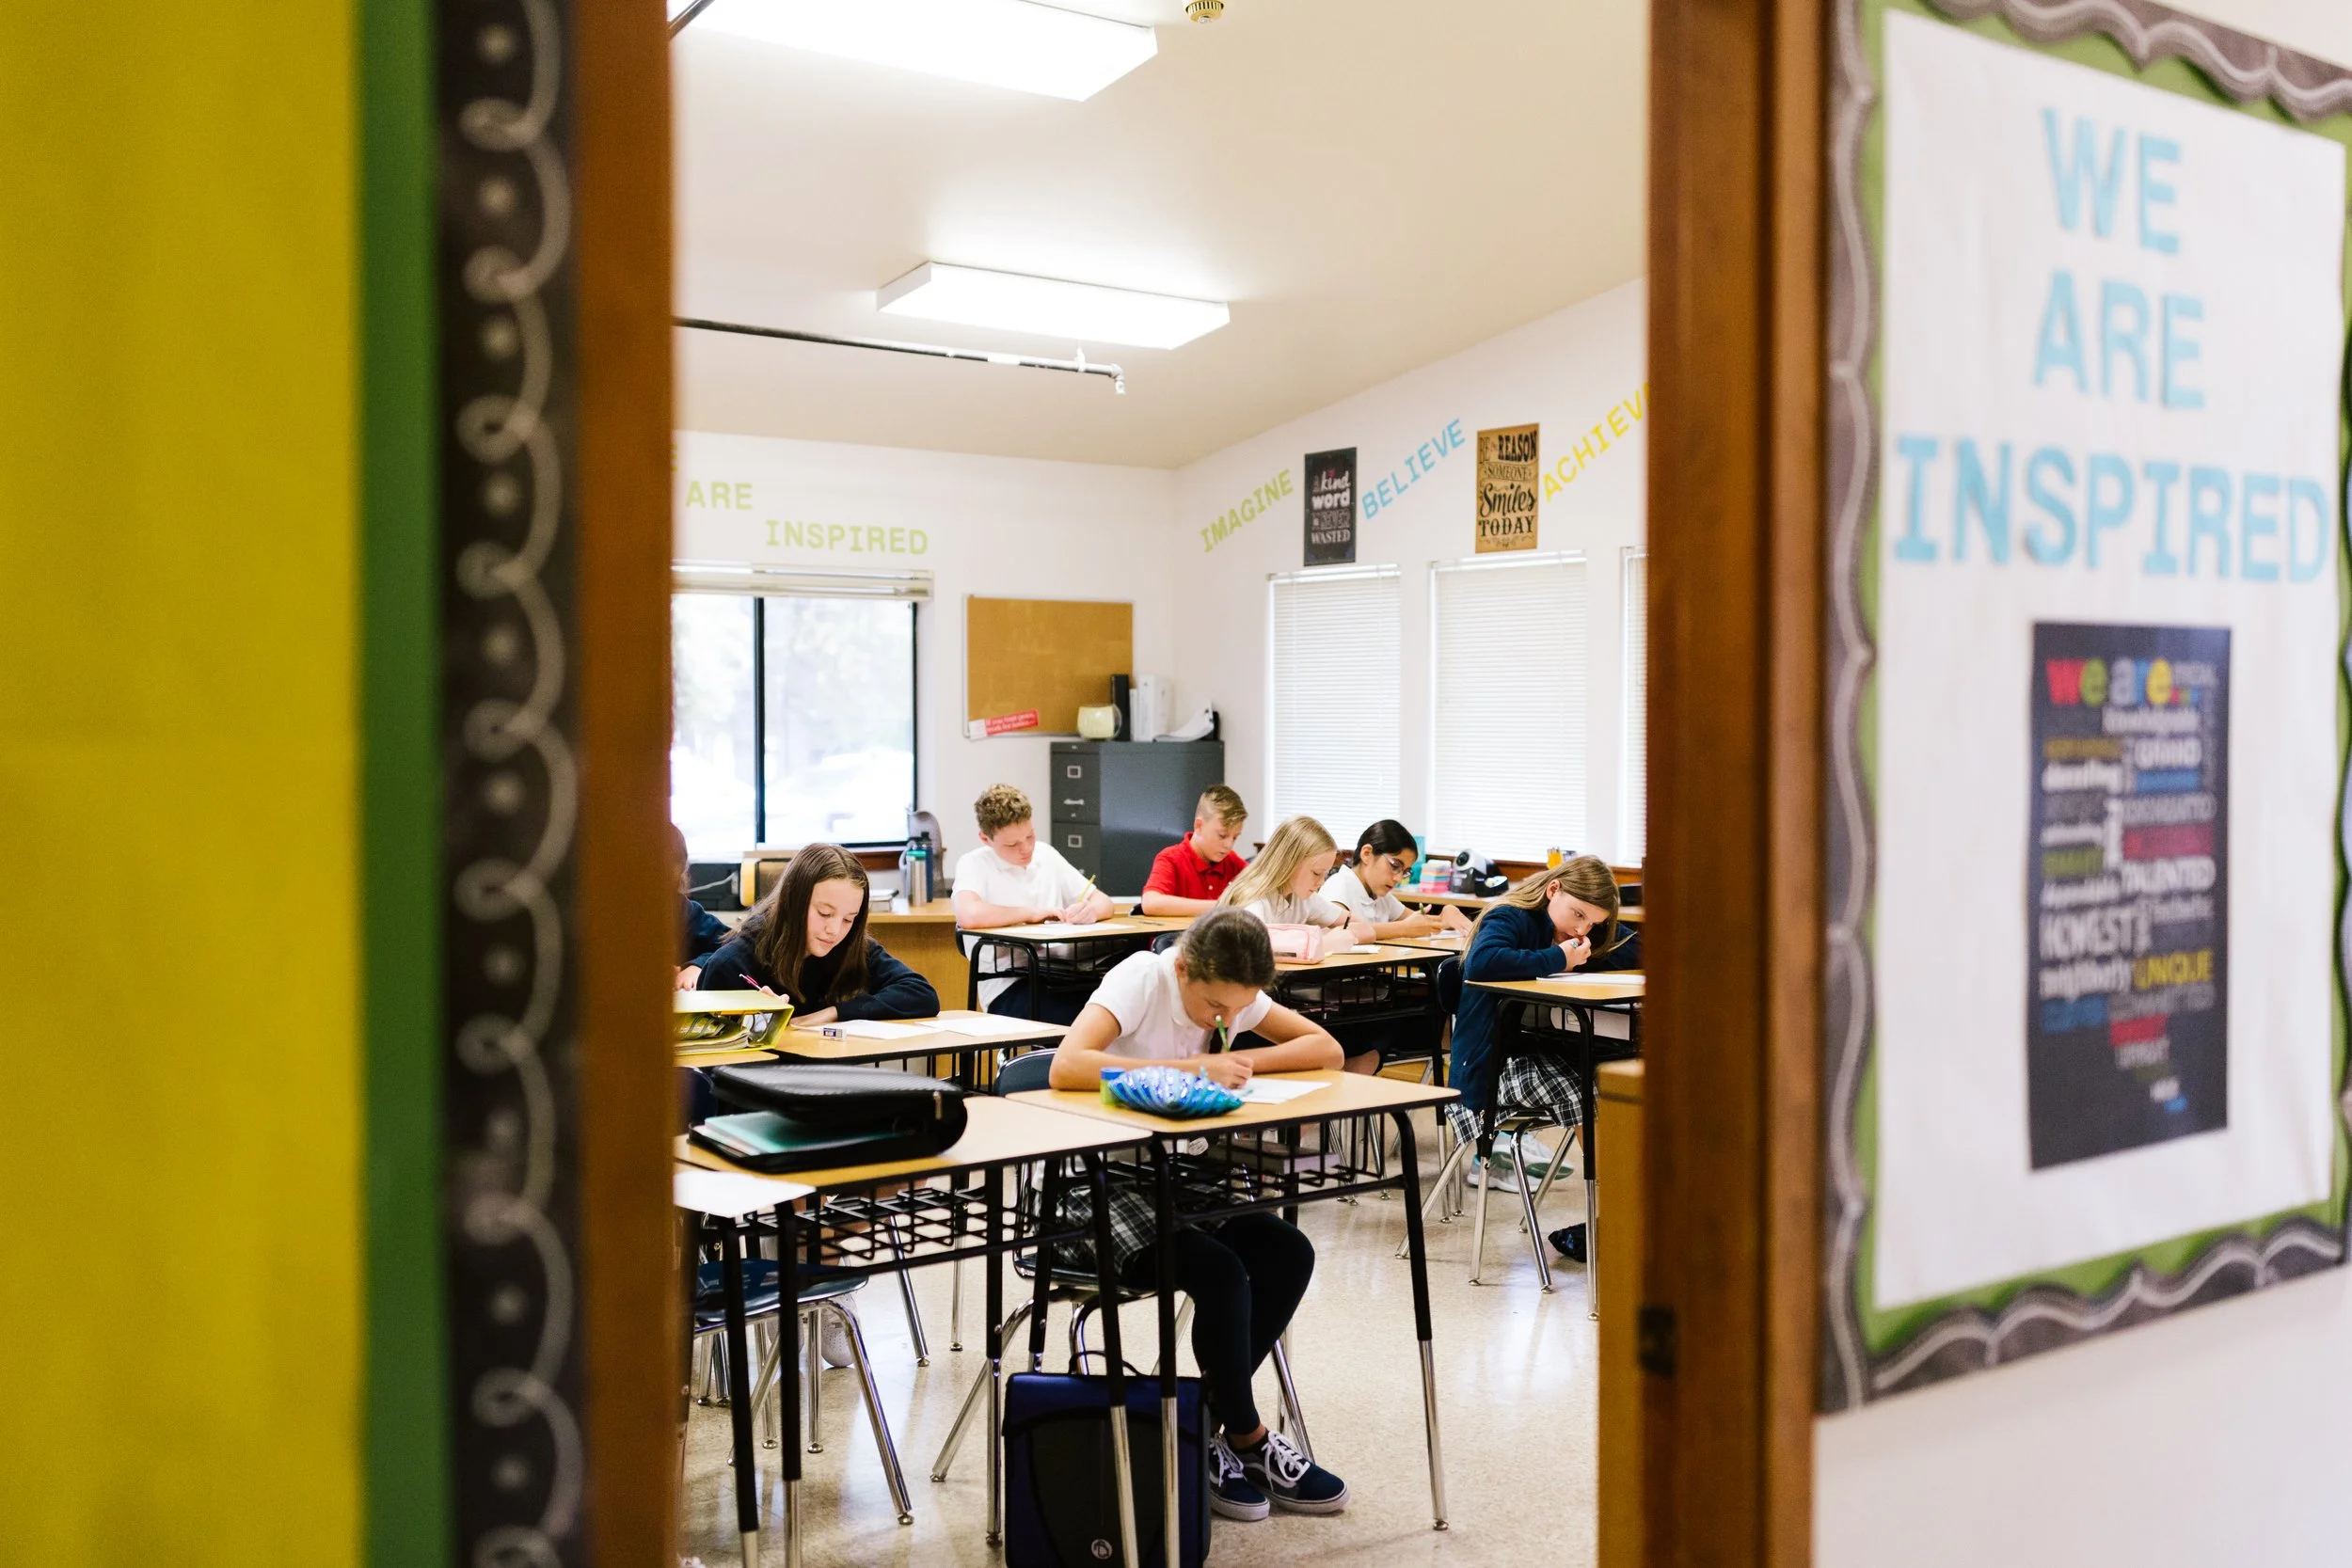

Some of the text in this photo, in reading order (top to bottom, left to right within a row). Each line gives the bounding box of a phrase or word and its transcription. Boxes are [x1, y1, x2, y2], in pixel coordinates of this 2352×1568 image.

[2041, 106, 2182, 255] WE
[2032, 269, 2206, 410] ARE
[1498, 430, 1537, 462] REASON
[1321, 469, 1351, 491] kind
[1361, 418, 1465, 519] BELIEVE
[1487, 465, 1529, 481] SOMEONE
[686, 481, 753, 510] ARE
[1200, 468, 1294, 553] IMAGINE
[1311, 488, 1350, 510] word
[1480, 483, 1535, 517] Smiles
[1893, 433, 2330, 584] INSPIRED
[765, 519, 929, 555] INSPIRED
[1311, 529, 1350, 545] WASTED
[1479, 515, 1535, 537] TODAY
[2045, 657, 2107, 705] we
